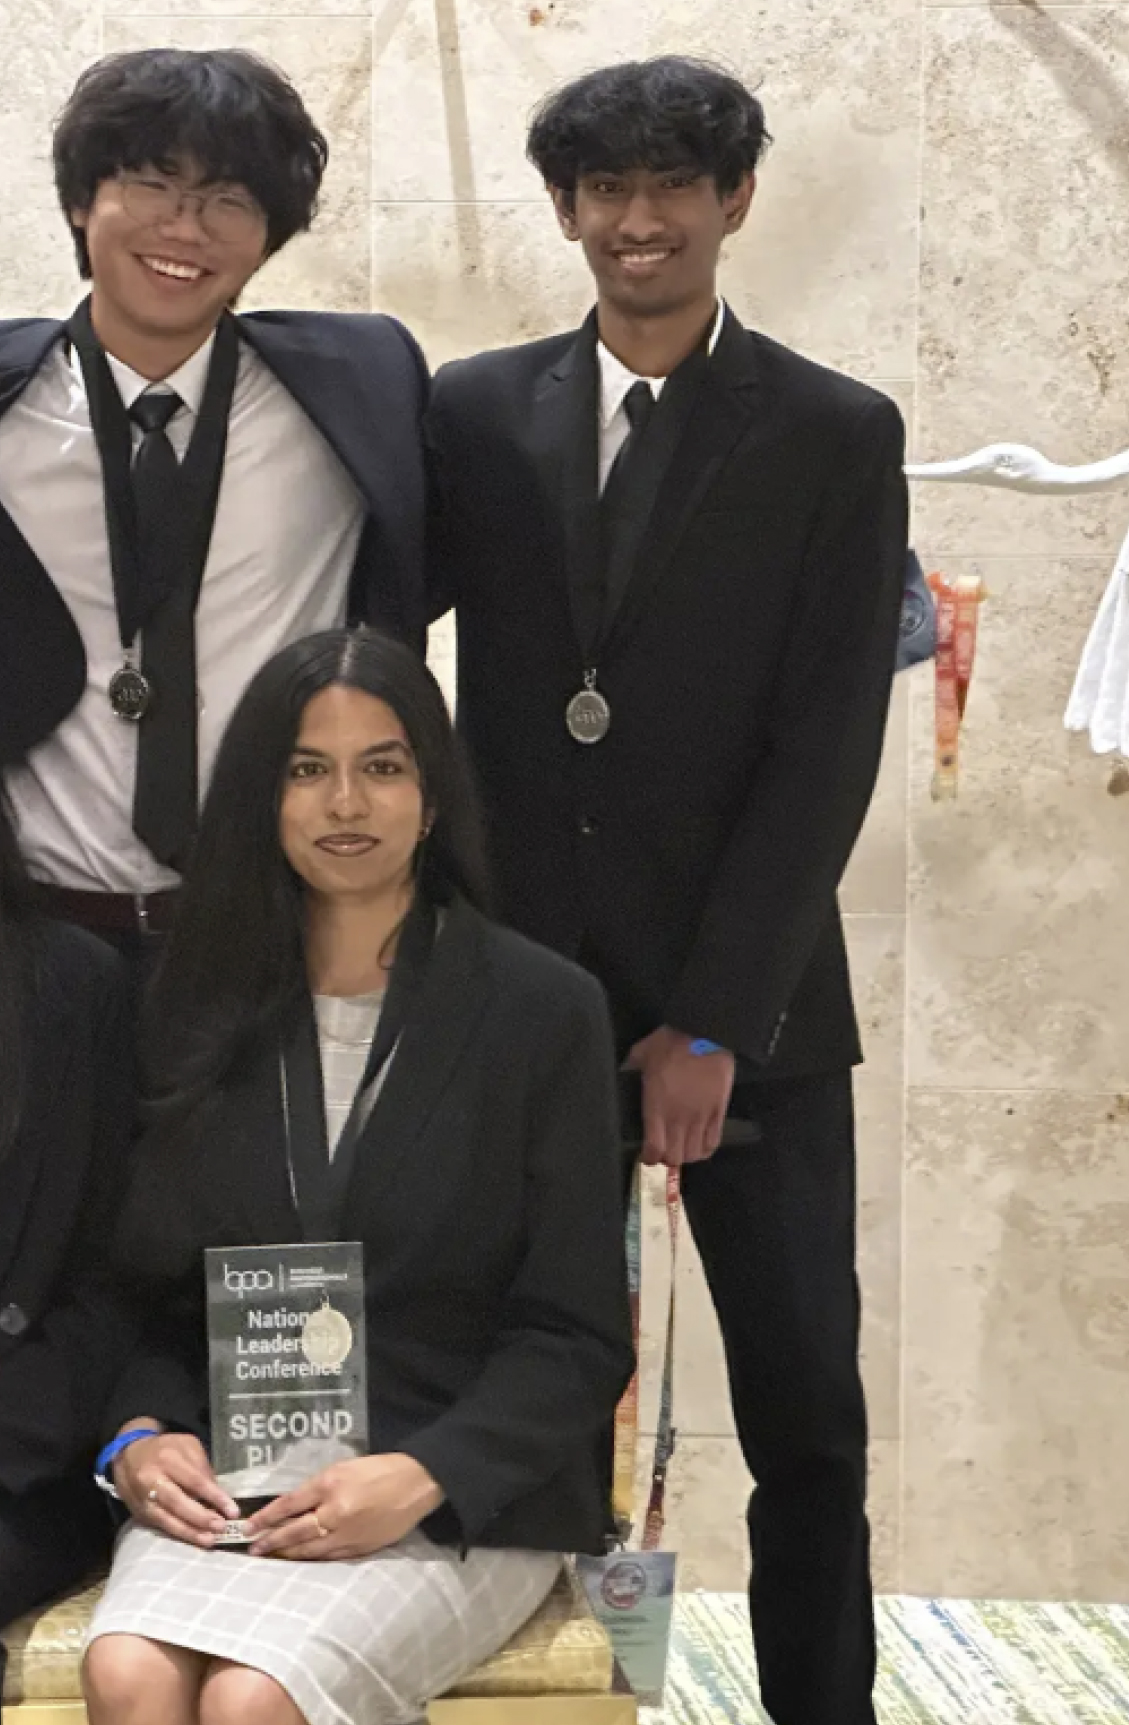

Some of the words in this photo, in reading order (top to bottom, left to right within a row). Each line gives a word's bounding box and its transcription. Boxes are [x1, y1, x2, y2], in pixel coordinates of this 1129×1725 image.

[247, 1307, 312, 1329] Nation
[235, 1358, 343, 1380] Conference
[229, 1410, 353, 1440] SECOND
